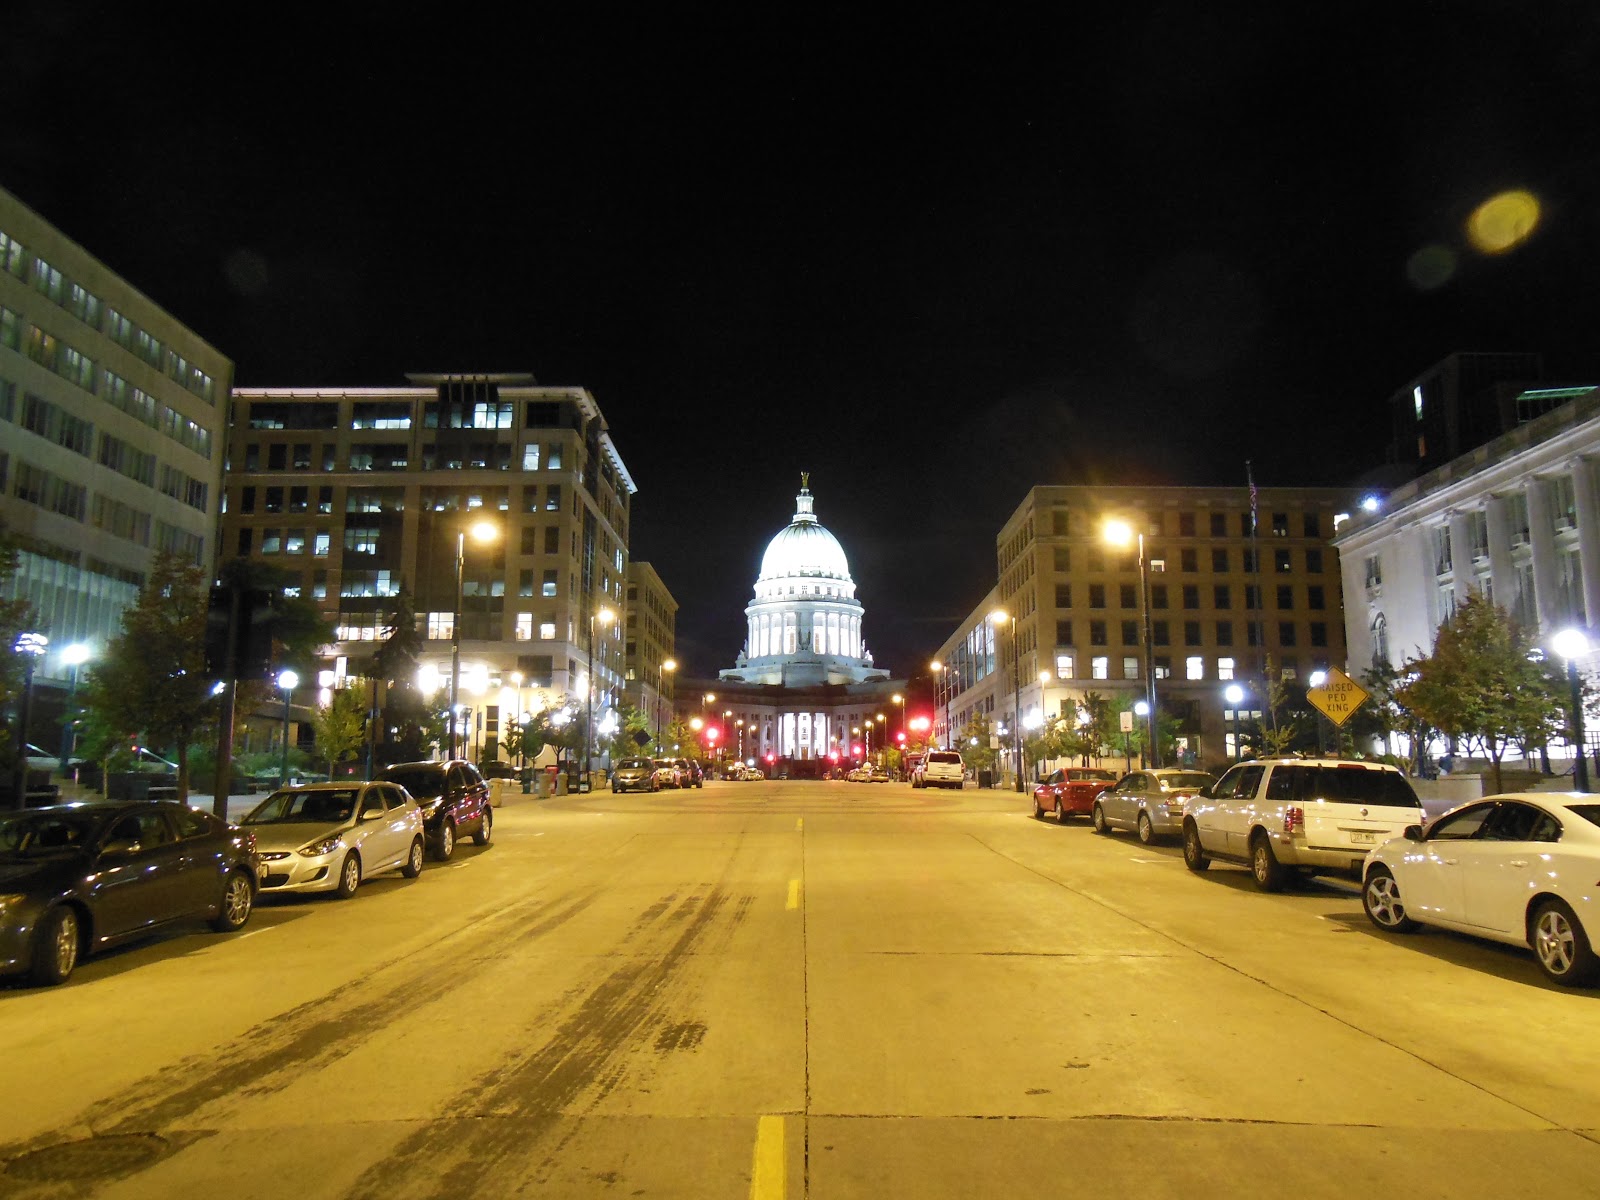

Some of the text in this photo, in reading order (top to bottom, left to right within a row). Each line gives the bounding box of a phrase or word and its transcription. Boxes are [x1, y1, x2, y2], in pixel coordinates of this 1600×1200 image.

[1320, 683, 1353, 691] RAISED
[1328, 693, 1346, 702] PED
[1326, 703, 1349, 711] XING
